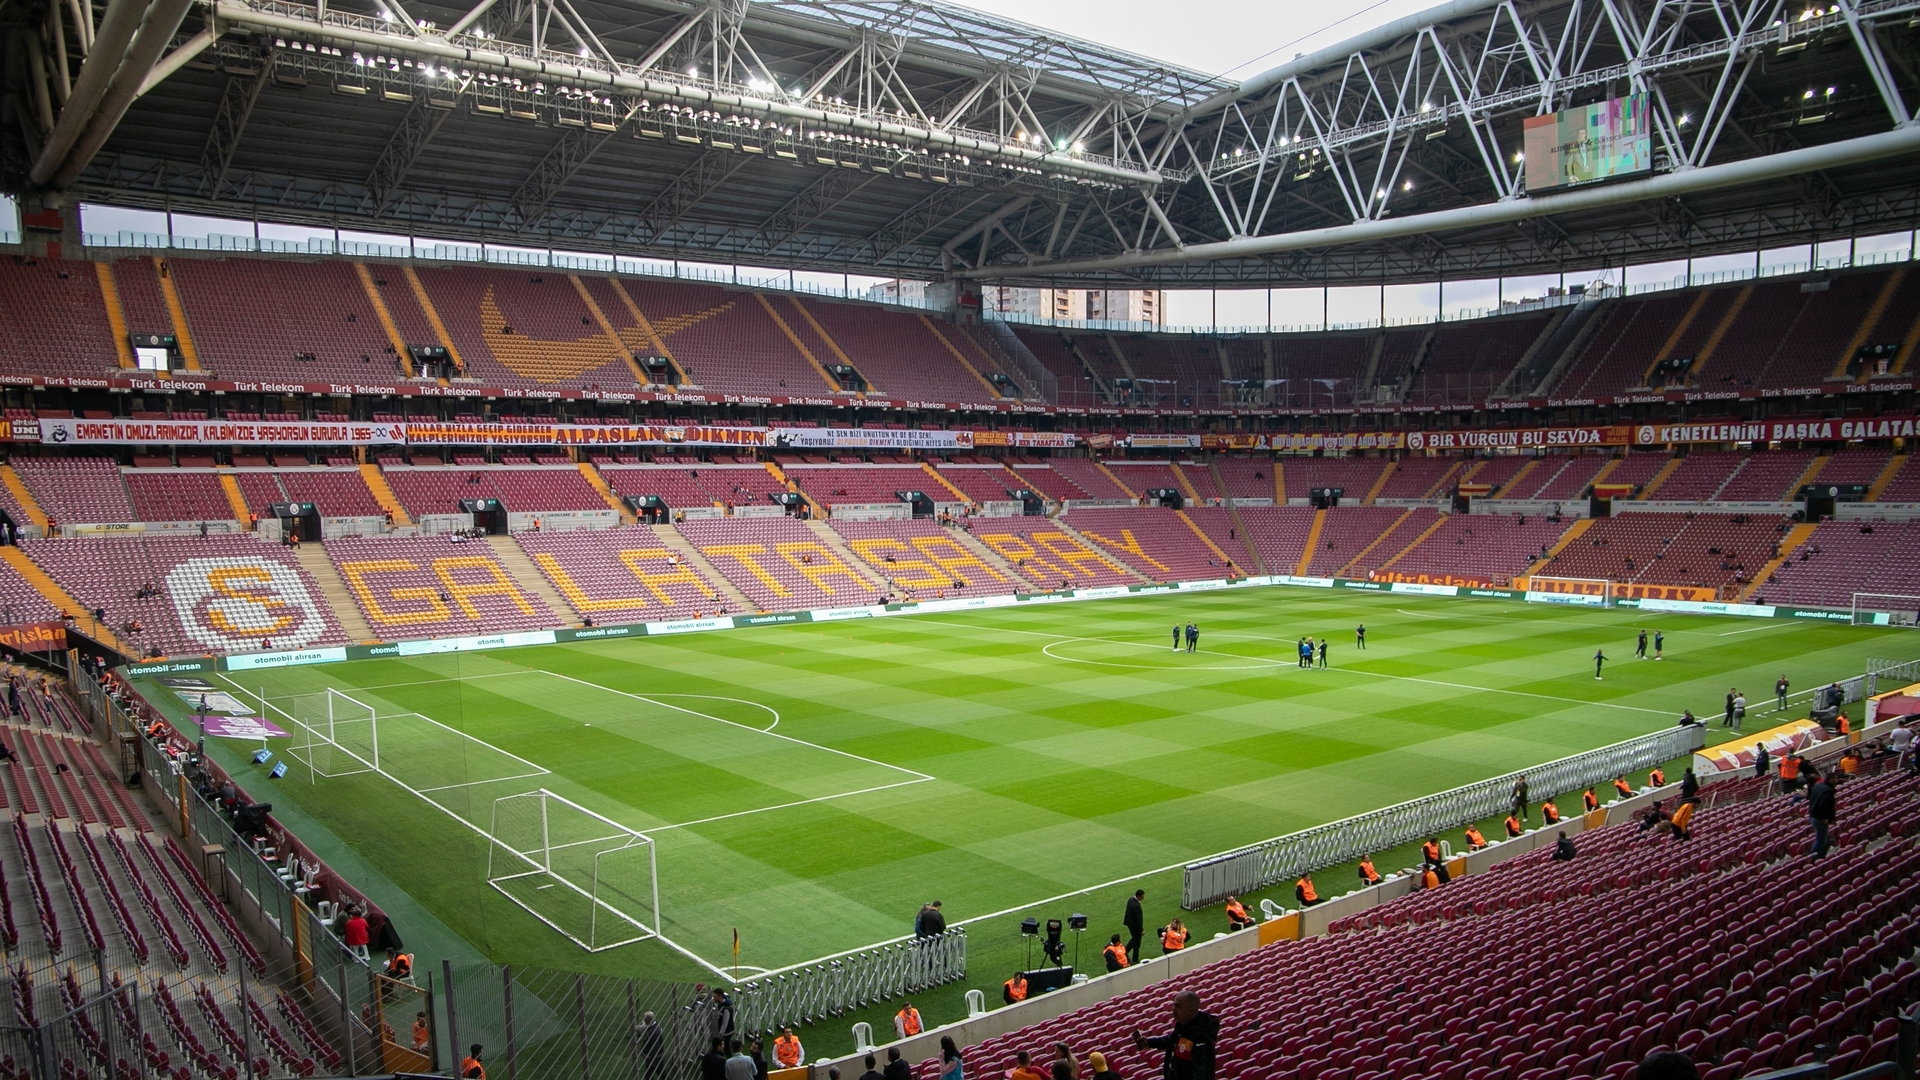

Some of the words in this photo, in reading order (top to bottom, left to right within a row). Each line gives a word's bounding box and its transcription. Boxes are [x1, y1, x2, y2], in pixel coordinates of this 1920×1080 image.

[0, 375, 33, 383] lekom
[43, 376, 65, 385] Türk
[67, 377, 108, 386] Telekom
[130, 379, 155, 388] Türk
[158, 379, 206, 390] Telekom
[234, 381, 257, 391] Türk
[260, 382, 304, 392] Telekom
[330, 384, 352, 393] Türk
[354, 385, 395, 394] Telekom
[1846, 384, 1867, 393] Türk
[1870, 382, 1912, 392] Telekom
[419, 387, 440, 395] Türk
[442, 387, 481, 396] Telekom
[503, 388, 522, 396] Türk
[525, 389, 560, 398] Telekom
[601, 391, 635, 400] Telekom
[1704, 391, 1739, 399] Telekom
[1761, 389, 1780, 397] Türk
[1783, 387, 1821, 396] Telekom
[675, 393, 705, 401] Telekom
[788, 396, 803, 404] Türk
[805, 397, 833, 405] Telekom
[865, 399, 891, 407] Telekom
[921, 401, 946, 409] Telekom
[1501, 401, 1529, 409] Telekom
[1564, 398, 1594, 406] Telekom
[974, 403, 997, 411] Telekom
[13, 426, 39, 434] UNI
[76, 423, 123, 440] EMANETİN
[203, 424, 255, 441] KALBİMİZDE
[311, 427, 348, 441] GURURLA
[1661, 424, 1766, 442] KENETLENİN!
[1773, 422, 1833, 440] BAŞKA
[554, 426, 662, 445] ALPASLAN
[1429, 433, 1455, 447] BİR
[1458, 432, 1519, 447] VURGUN
[1522, 432, 1544, 445] BU
[1546, 428, 1601, 445] SEVDA
[342, 529, 1169, 625] GALATASARAY
[1531, 580, 1696, 601] GALATASARAY
[1794, 611, 1827, 619] otomobil
[750, 616, 777, 624] otomobil
[666, 623, 695, 631] otomobil
[575, 629, 606, 638] otomobil
[254, 655, 293, 665] otomobil
[294, 652, 322, 662] alırsan
